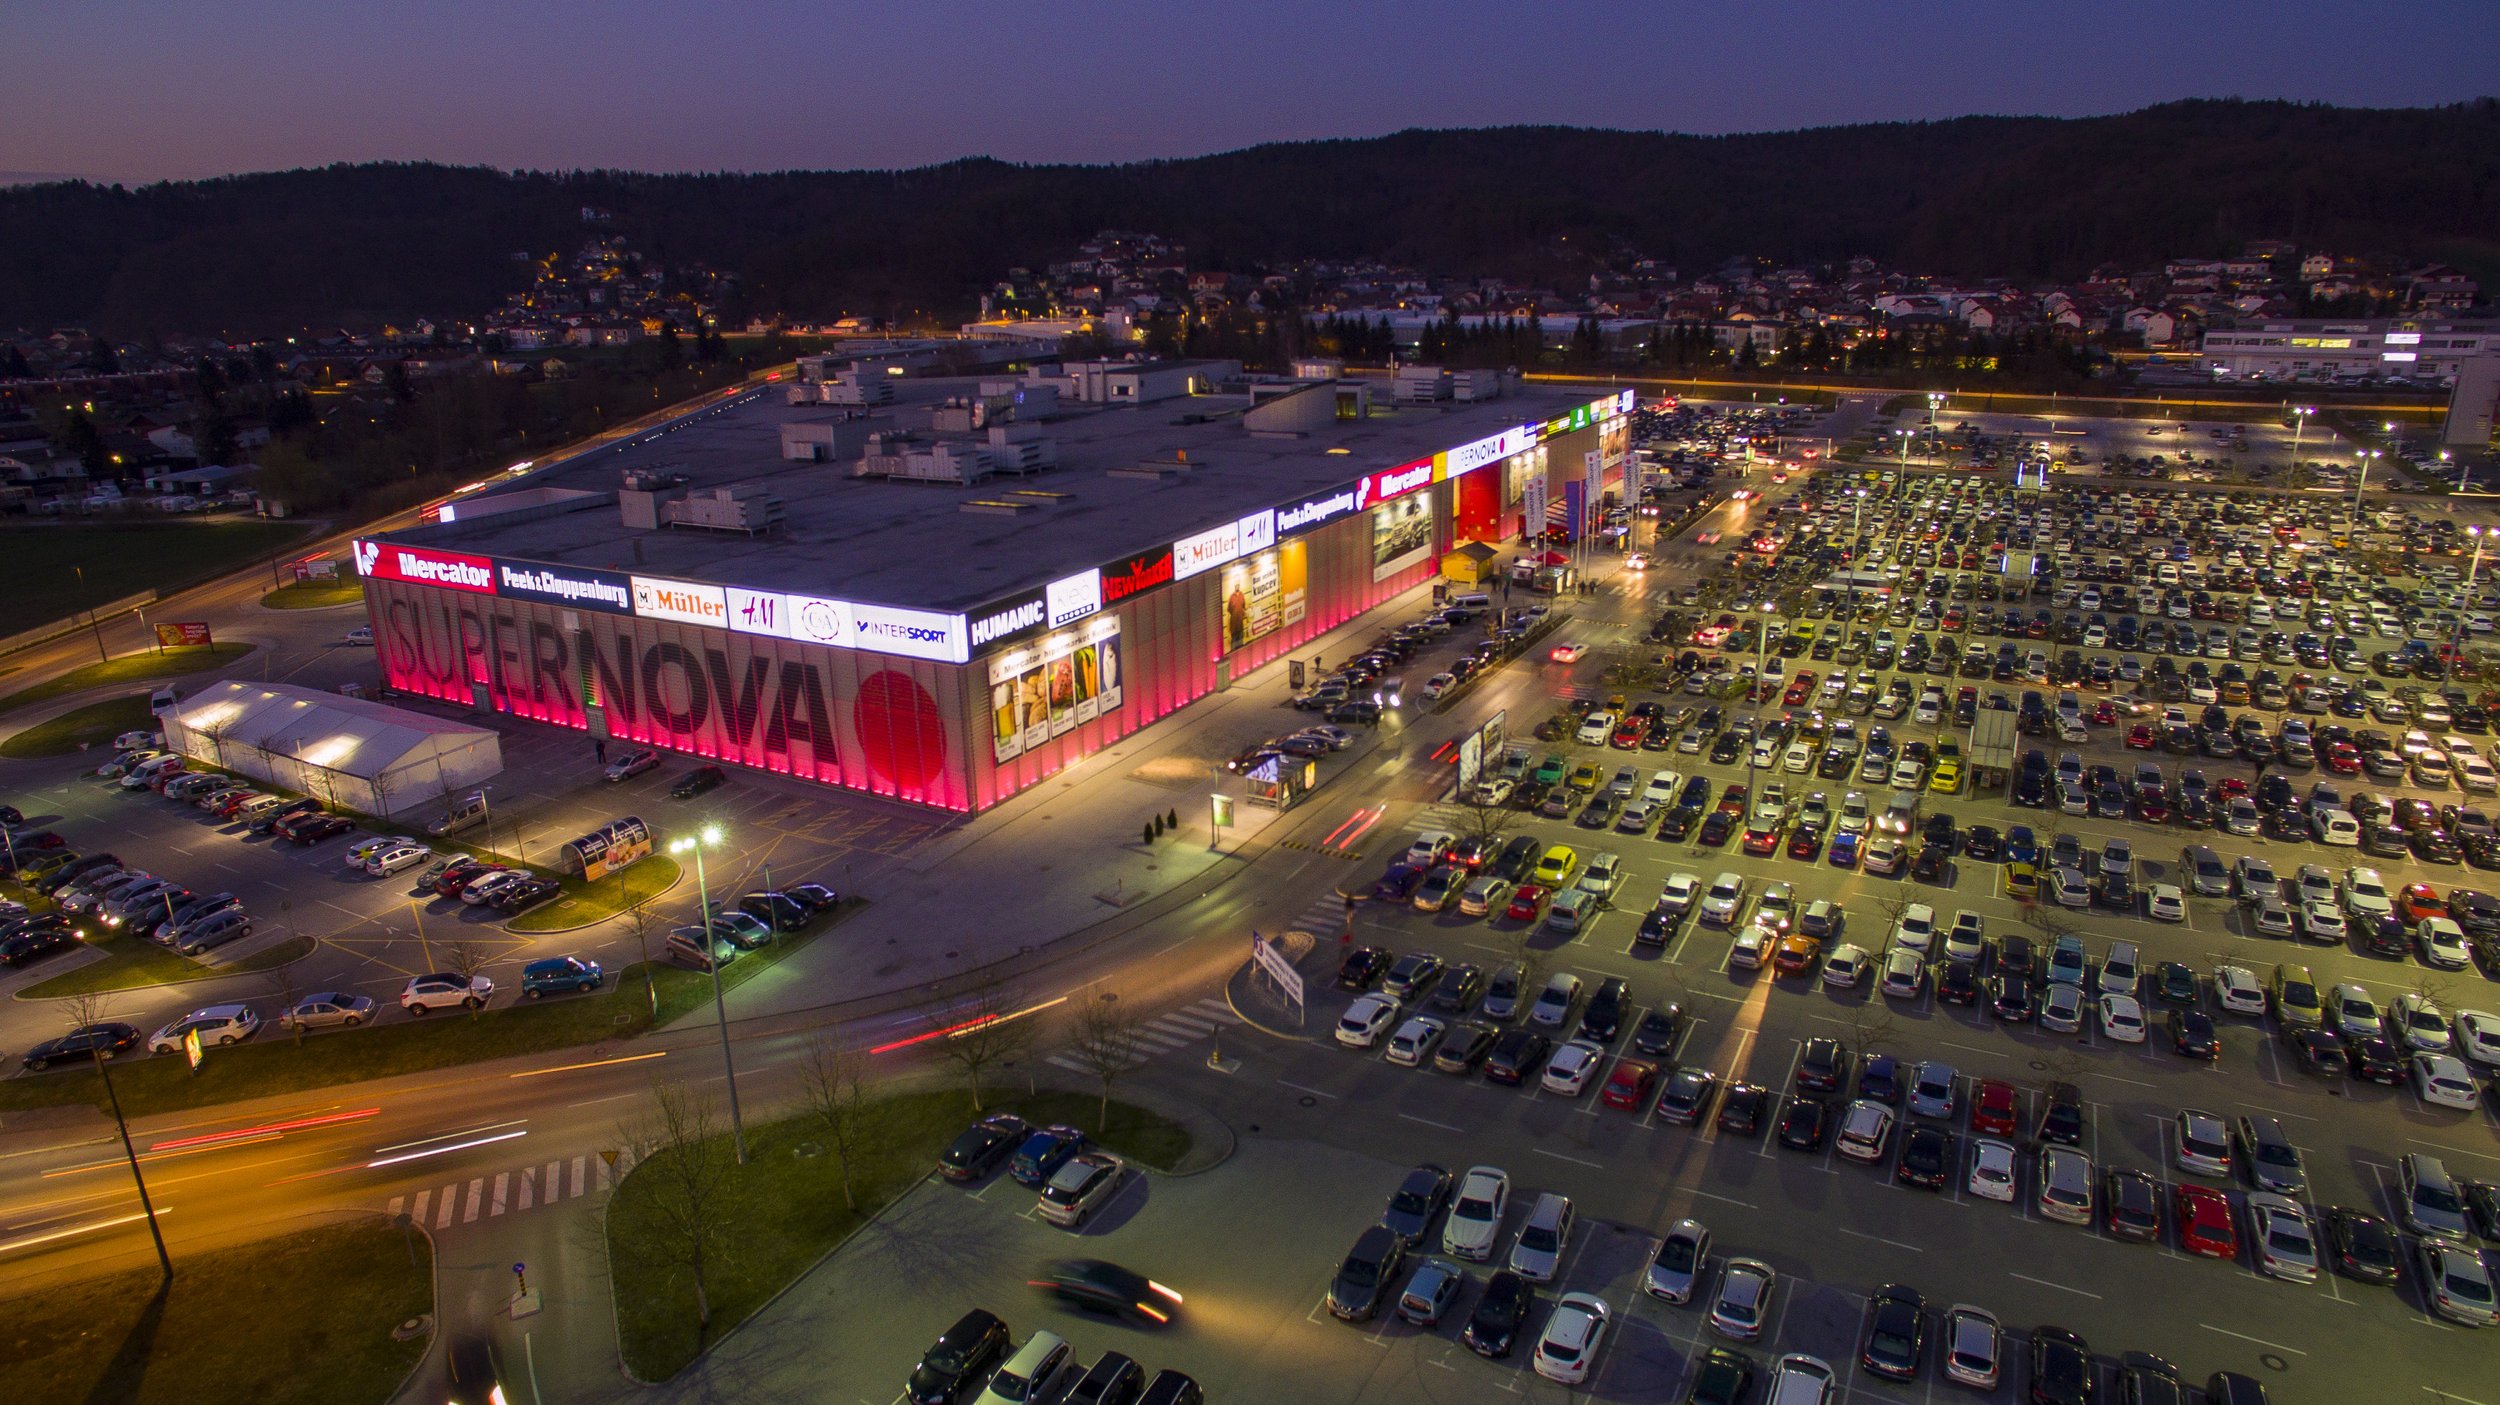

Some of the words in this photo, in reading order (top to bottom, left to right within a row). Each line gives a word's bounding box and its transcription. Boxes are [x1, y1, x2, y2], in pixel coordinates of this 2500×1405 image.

[1381, 465, 1432, 498] Mercator
[1193, 537, 1236, 564] Müller
[398, 553, 490, 587] Mercator
[656, 590, 724, 617] Müller
[870, 622, 946, 644] INTERSPORT
[971, 600, 1045, 646] HUMANIC
[387, 600, 839, 766] SUPERNOVA
